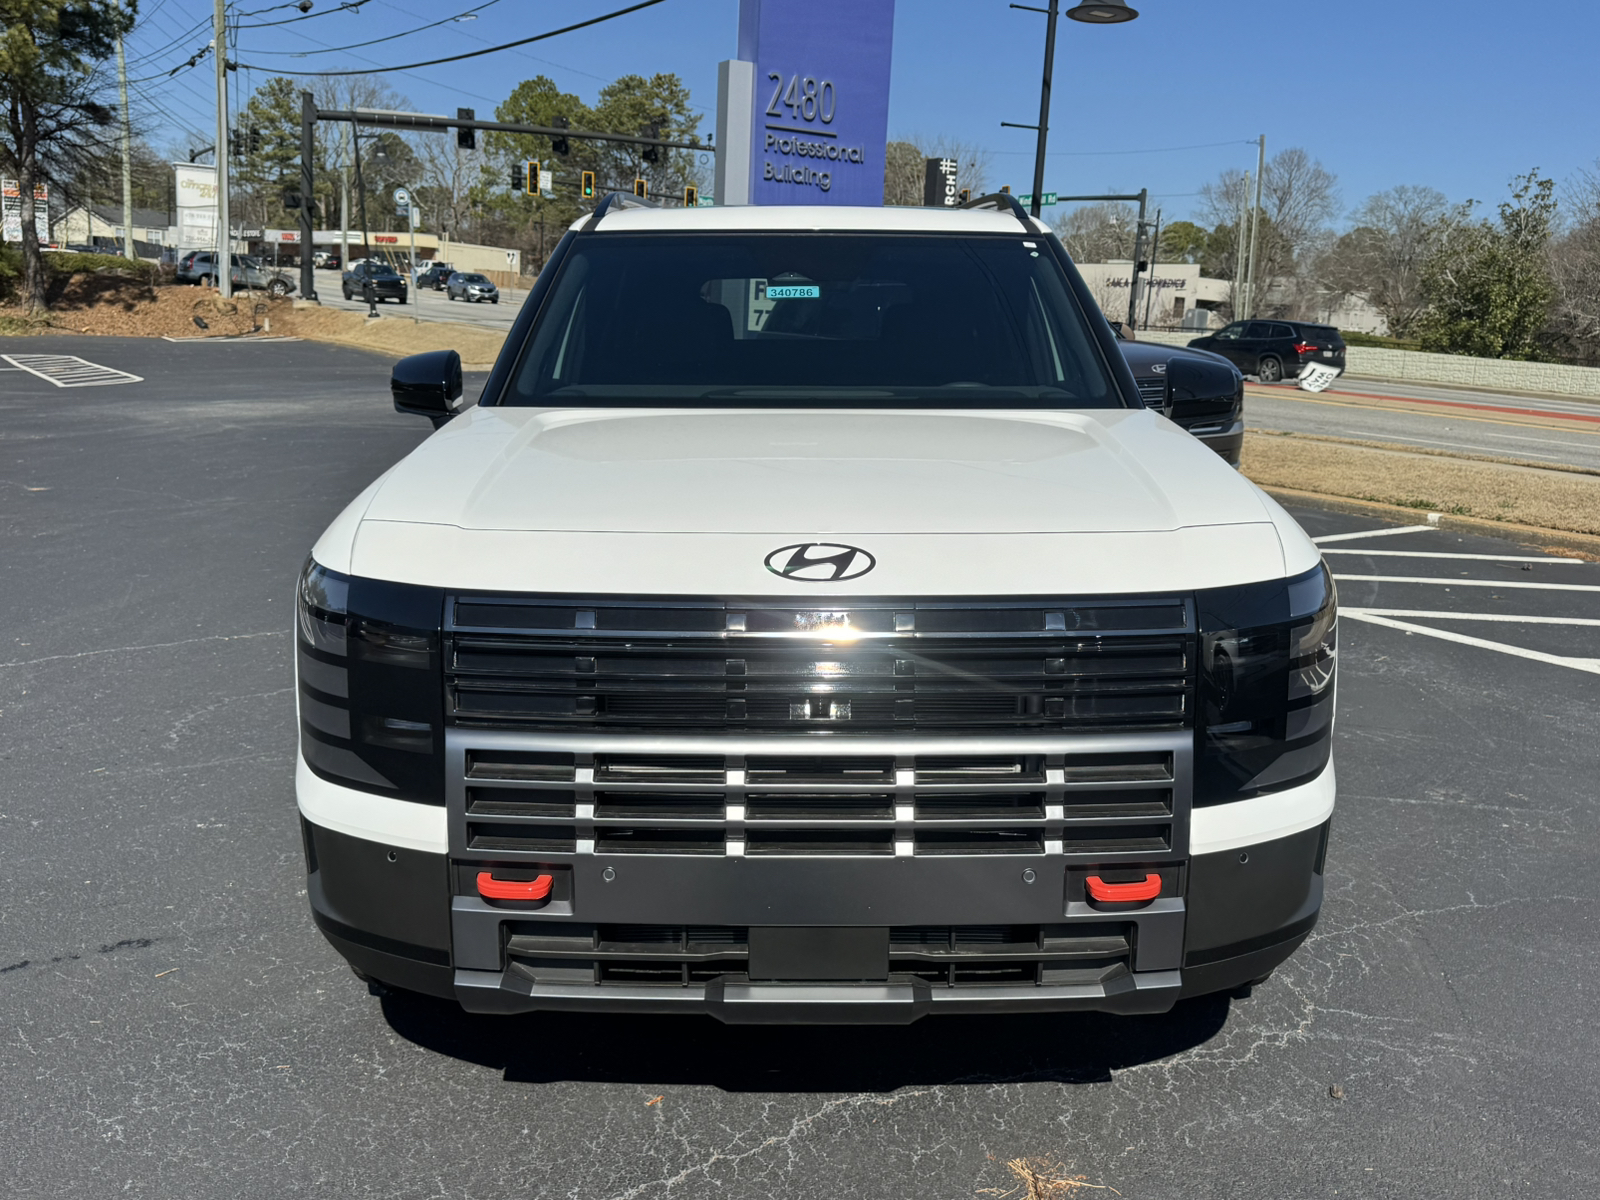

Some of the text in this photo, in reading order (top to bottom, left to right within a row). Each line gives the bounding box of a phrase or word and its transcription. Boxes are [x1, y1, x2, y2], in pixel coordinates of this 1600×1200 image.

[765, 72, 836, 124] 2480
[764, 133, 864, 164] Professional
[763, 161, 832, 192] Building
[770, 288, 813, 297] 340786
[1306, 372, 1327, 387] WAY
[1313, 373, 1334, 389] ONE
